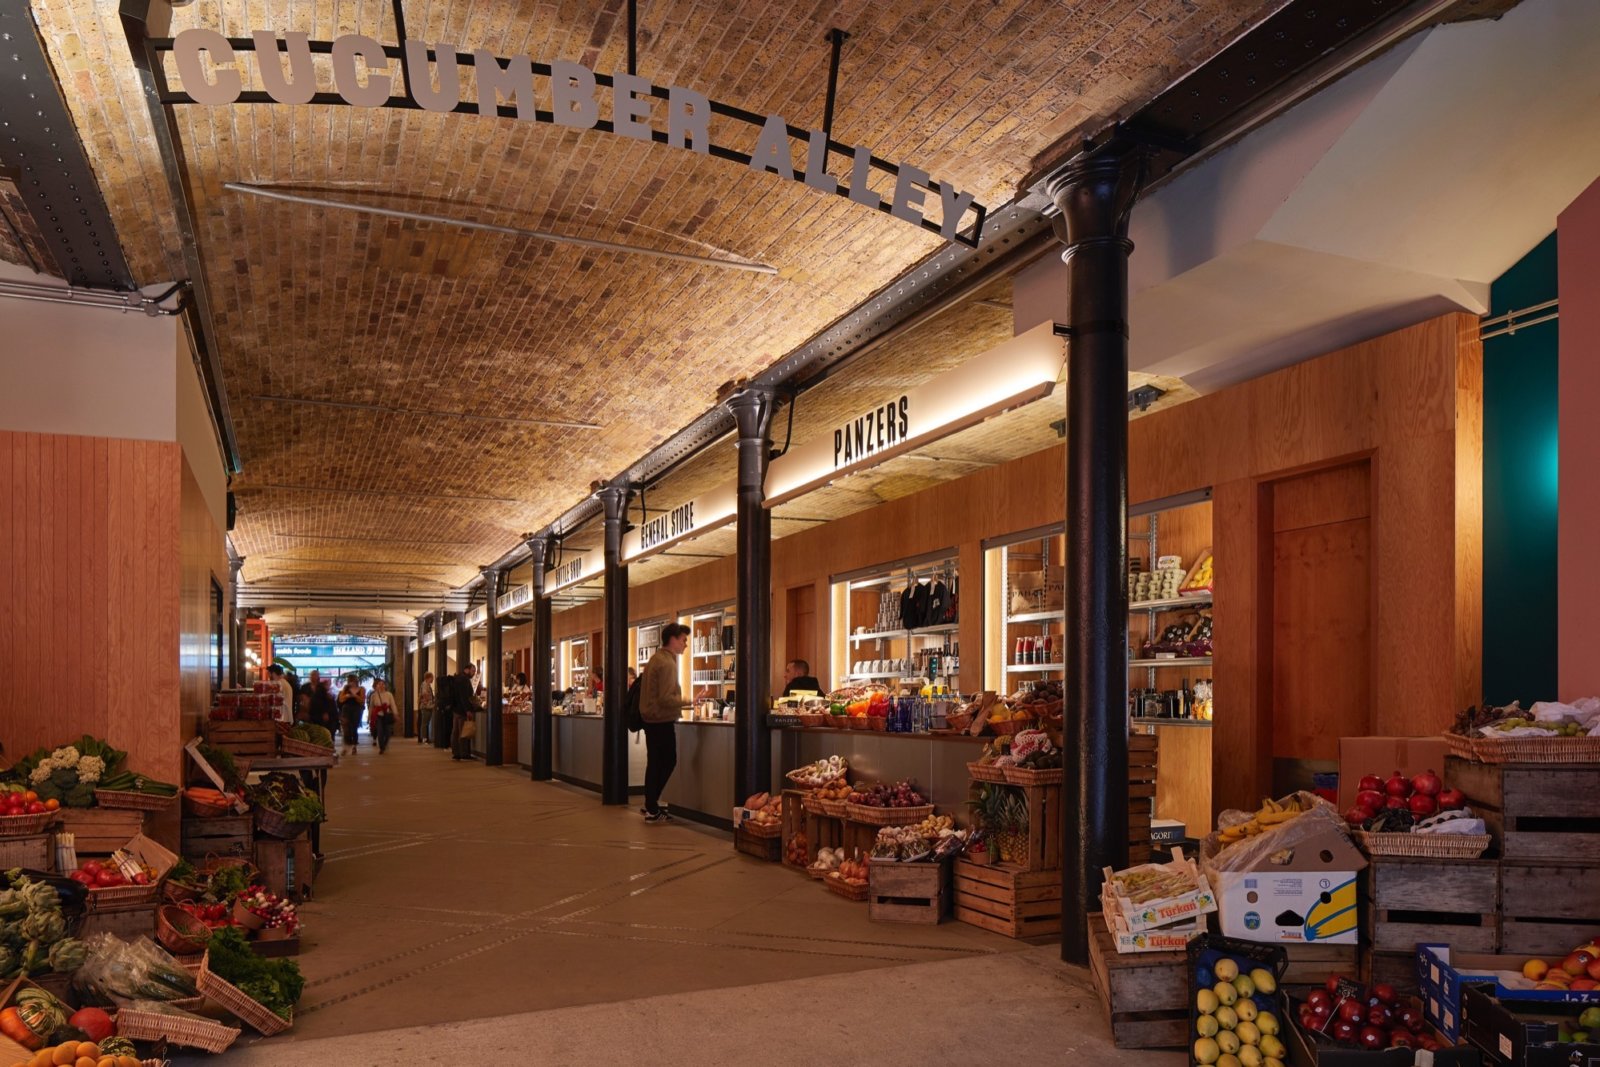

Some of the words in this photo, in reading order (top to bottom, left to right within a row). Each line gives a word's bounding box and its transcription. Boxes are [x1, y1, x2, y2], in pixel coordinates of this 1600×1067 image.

[172, 28, 711, 155] CUCUMBER
[748, 114, 975, 241] ALLEY
[834, 395, 908, 467] PANZERS
[641, 514, 669, 550] GENERAL
[671, 500, 694, 537] STORE
[1158, 901, 1197, 919] Türkan
